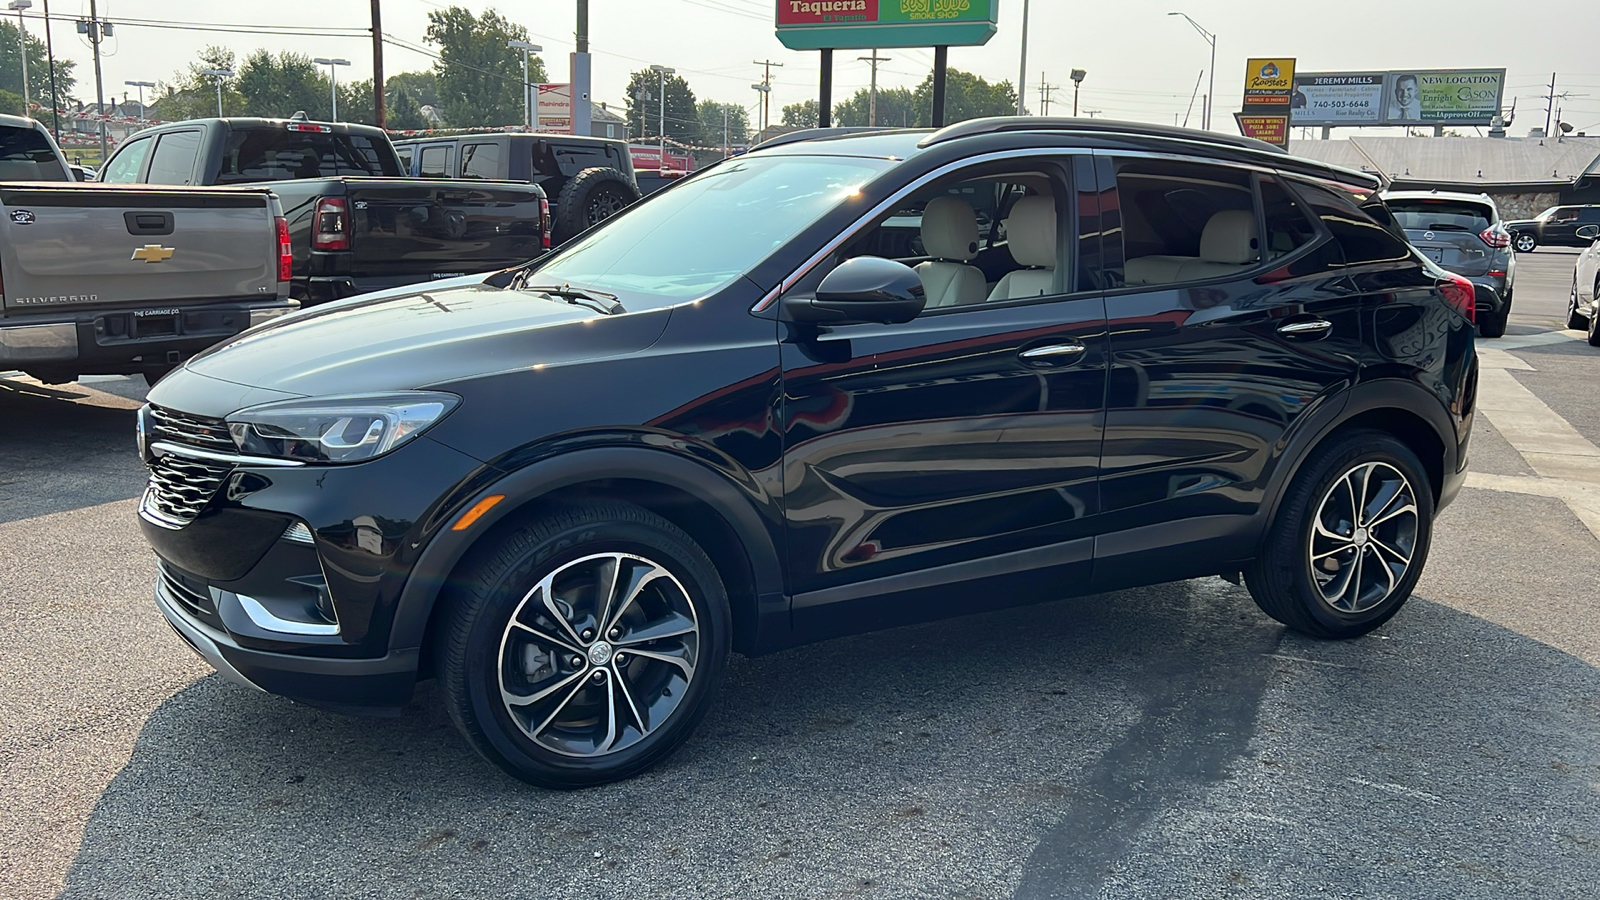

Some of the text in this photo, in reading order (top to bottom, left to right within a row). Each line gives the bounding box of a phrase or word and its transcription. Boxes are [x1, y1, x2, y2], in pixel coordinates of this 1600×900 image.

[790, 0, 866, 15] Taqueria
[909, 11, 959, 20] SMOKE SHOP
[1251, 77, 1288, 88] Roosters
[1314, 76, 1373, 85] JEREMY MILLS
[1421, 76, 1498, 84] NEW LOCATION
[1423, 94, 1453, 103] Enright
[16, 294, 99, 304] SILVERADO
